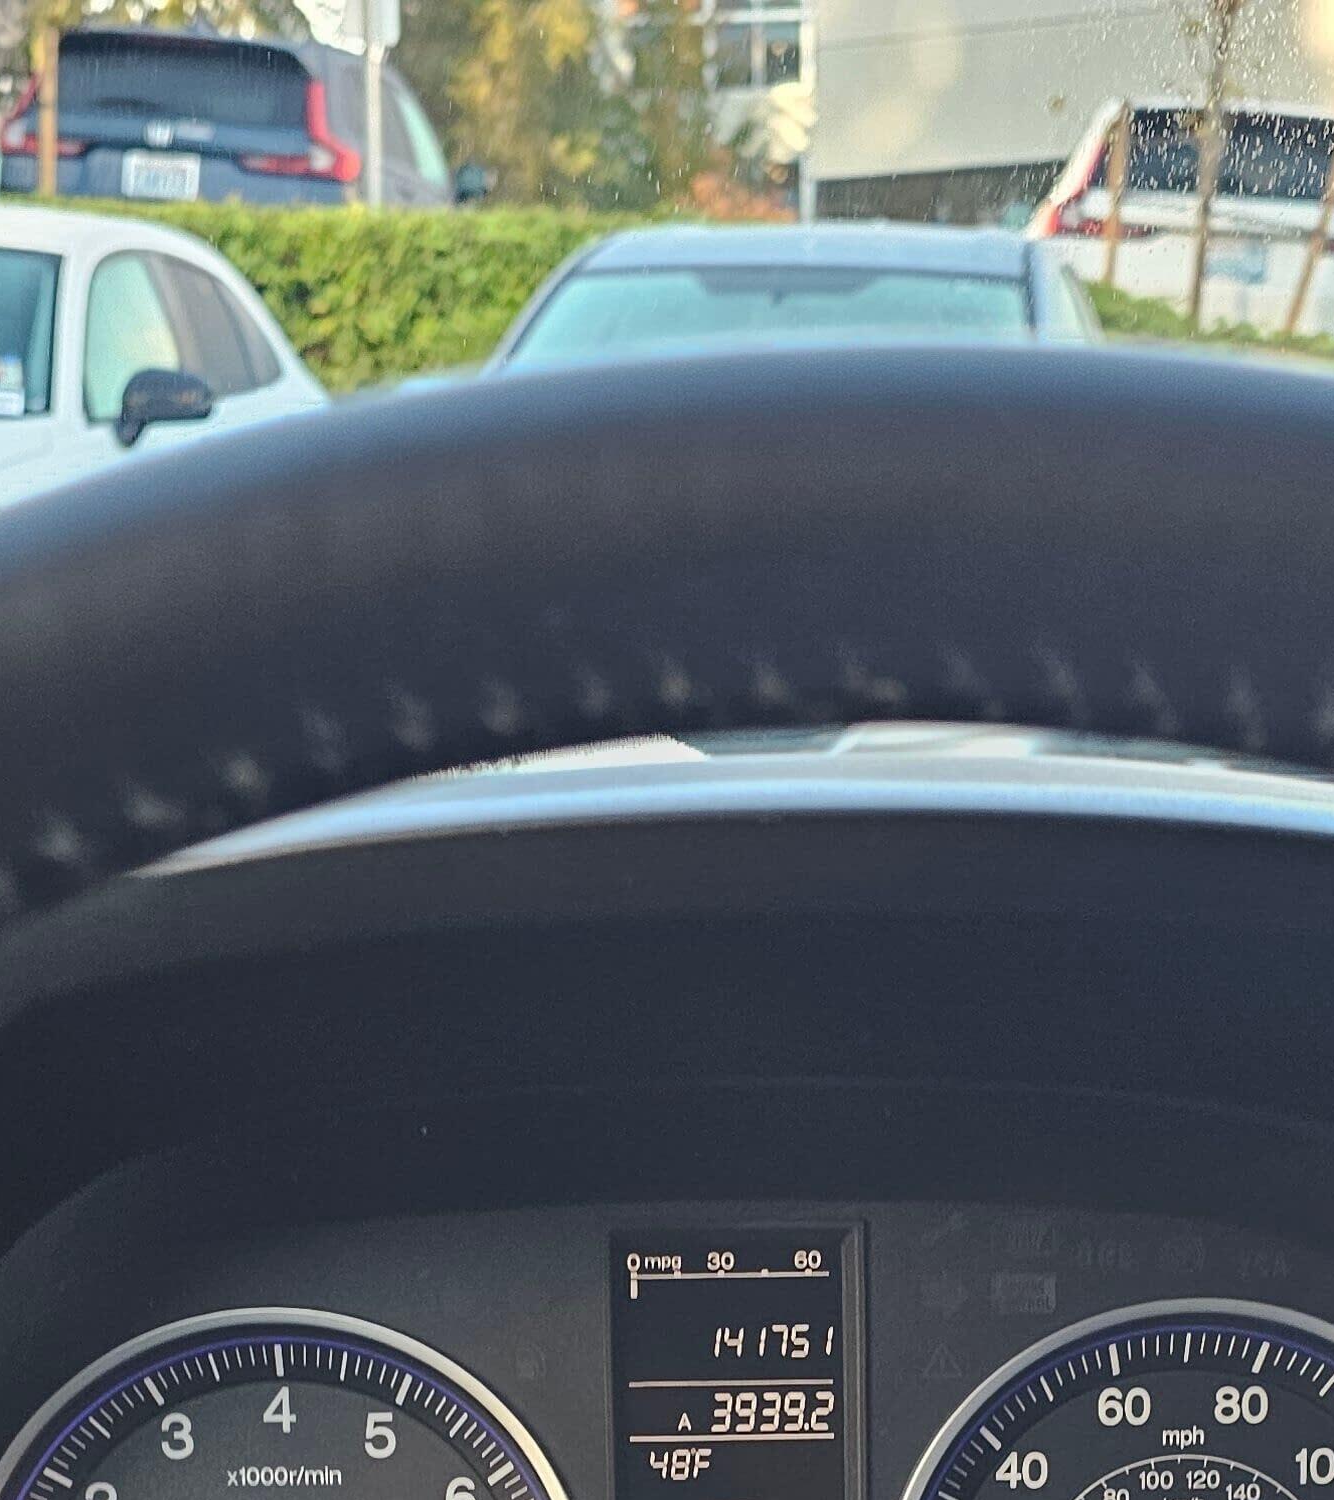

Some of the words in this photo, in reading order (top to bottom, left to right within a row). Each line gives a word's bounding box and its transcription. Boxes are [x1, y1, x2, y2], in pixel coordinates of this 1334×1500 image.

[626, 1253, 641, 1272] 0
[644, 1255, 682, 1270] mpg
[707, 1251, 735, 1271] 30
[794, 1249, 822, 1270] 60
[714, 1323, 834, 1358] 141751
[263, 1387, 296, 1433] 4
[677, 1412, 692, 1432] A
[710, 1390, 835, 1433] 3939.2
[1097, 1386, 1151, 1427] 60
[1214, 1385, 1269, 1425] 80
[161, 1412, 194, 1459] 3
[365, 1411, 397, 1459] 5
[1162, 1425, 1205, 1447] mph
[995, 1452, 1048, 1490] 40
[1139, 1470, 1174, 1491] 100
[1185, 1469, 1221, 1490] 120
